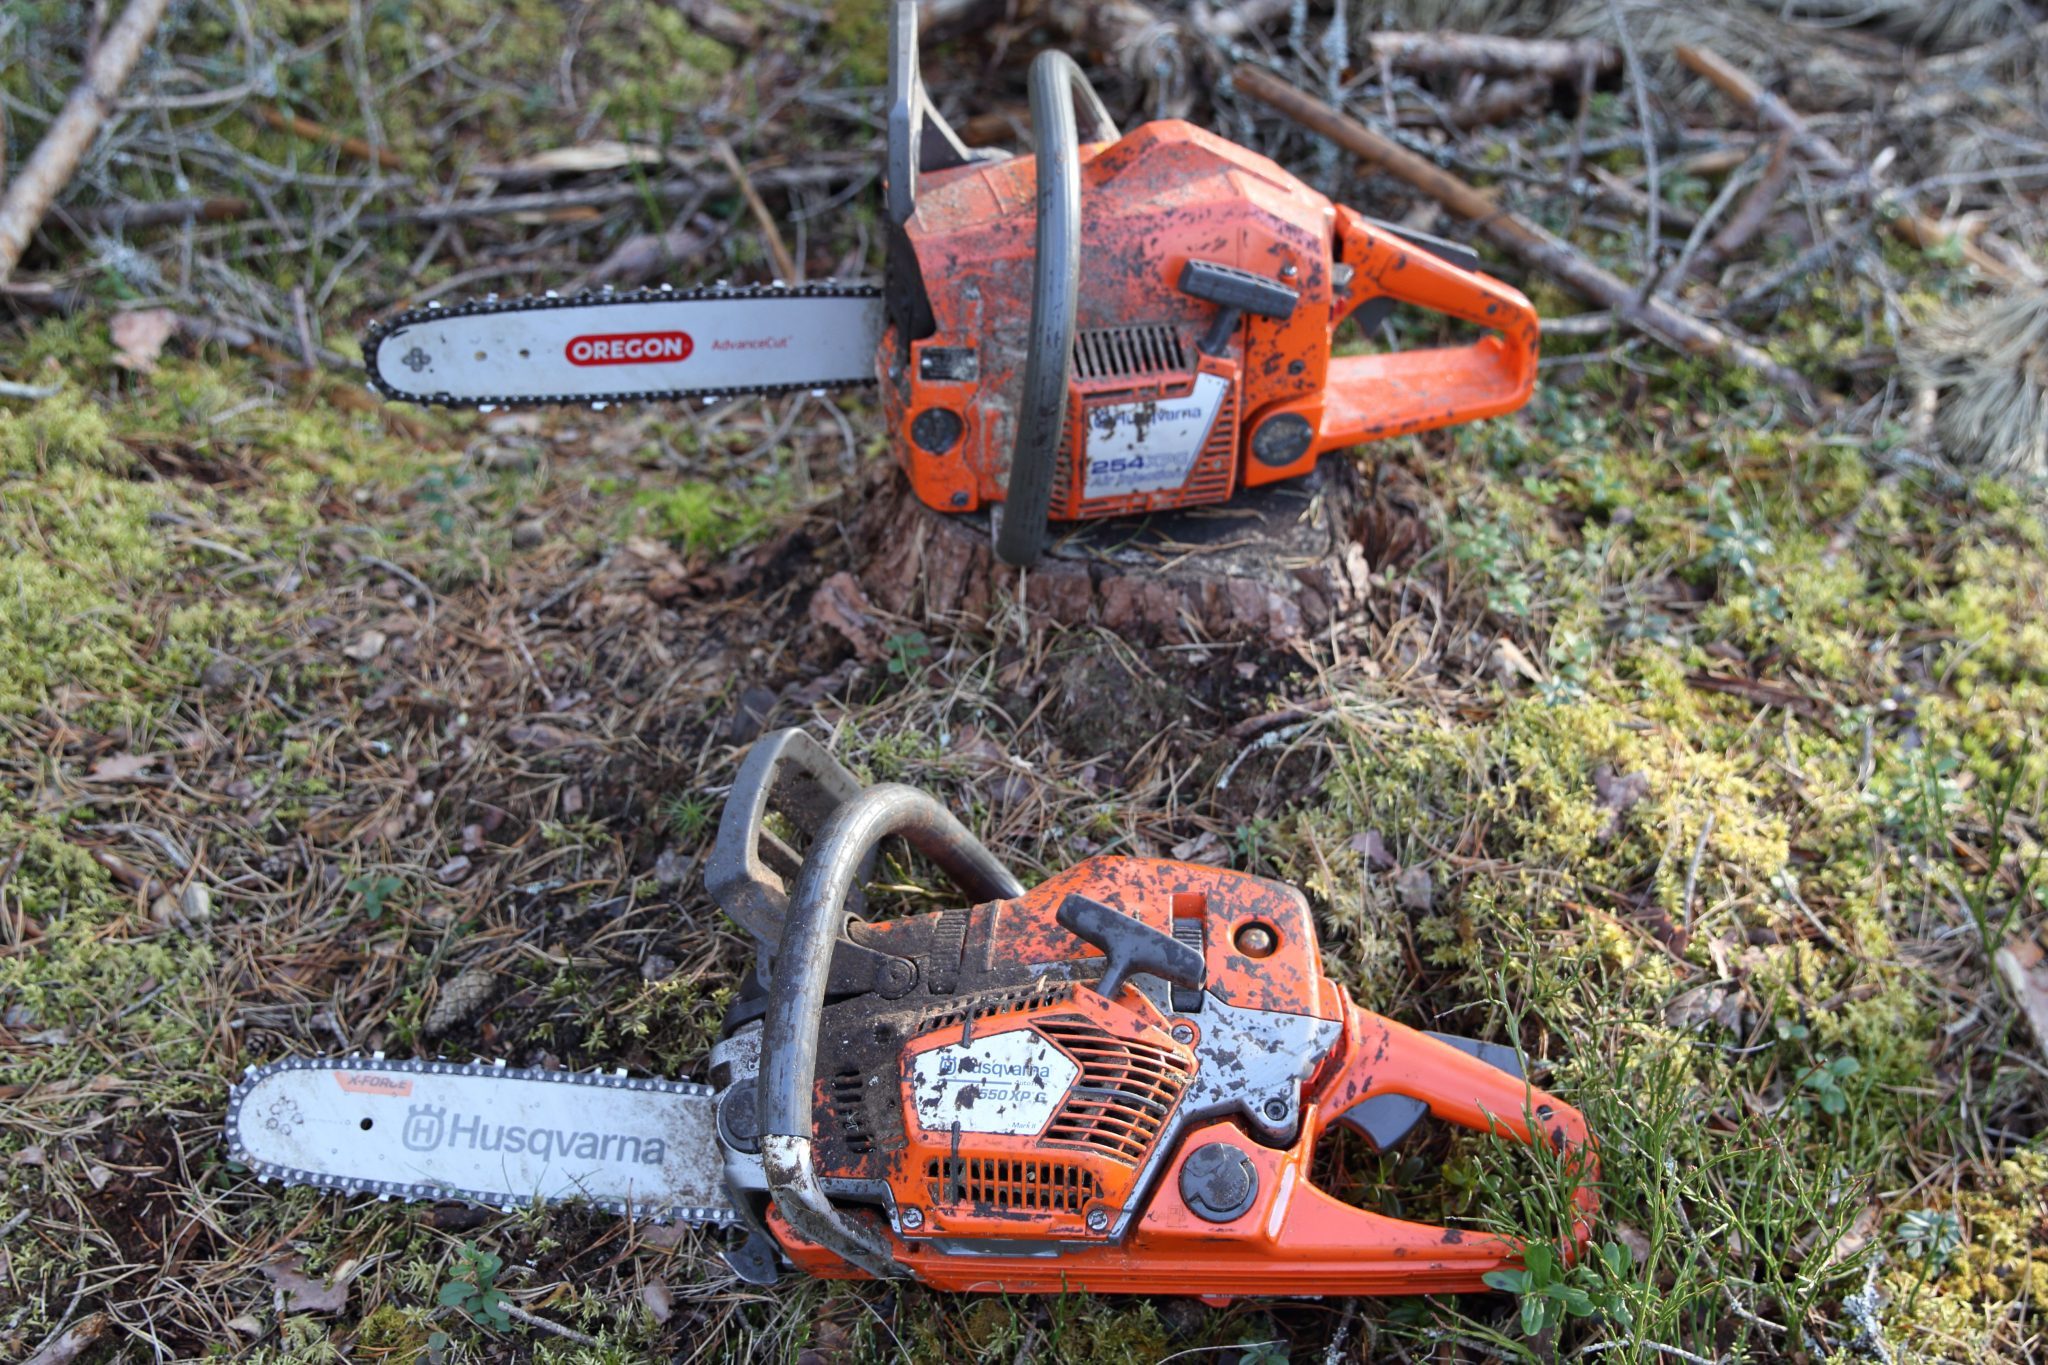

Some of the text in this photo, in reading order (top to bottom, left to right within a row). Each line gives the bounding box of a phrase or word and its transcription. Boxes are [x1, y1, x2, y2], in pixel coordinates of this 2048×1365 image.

[572, 337, 683, 361] OREGON
[711, 336, 788, 351] AdvanceCut
[1091, 455, 1144, 474] 254
[448, 1113, 666, 1165] Husqvarna
